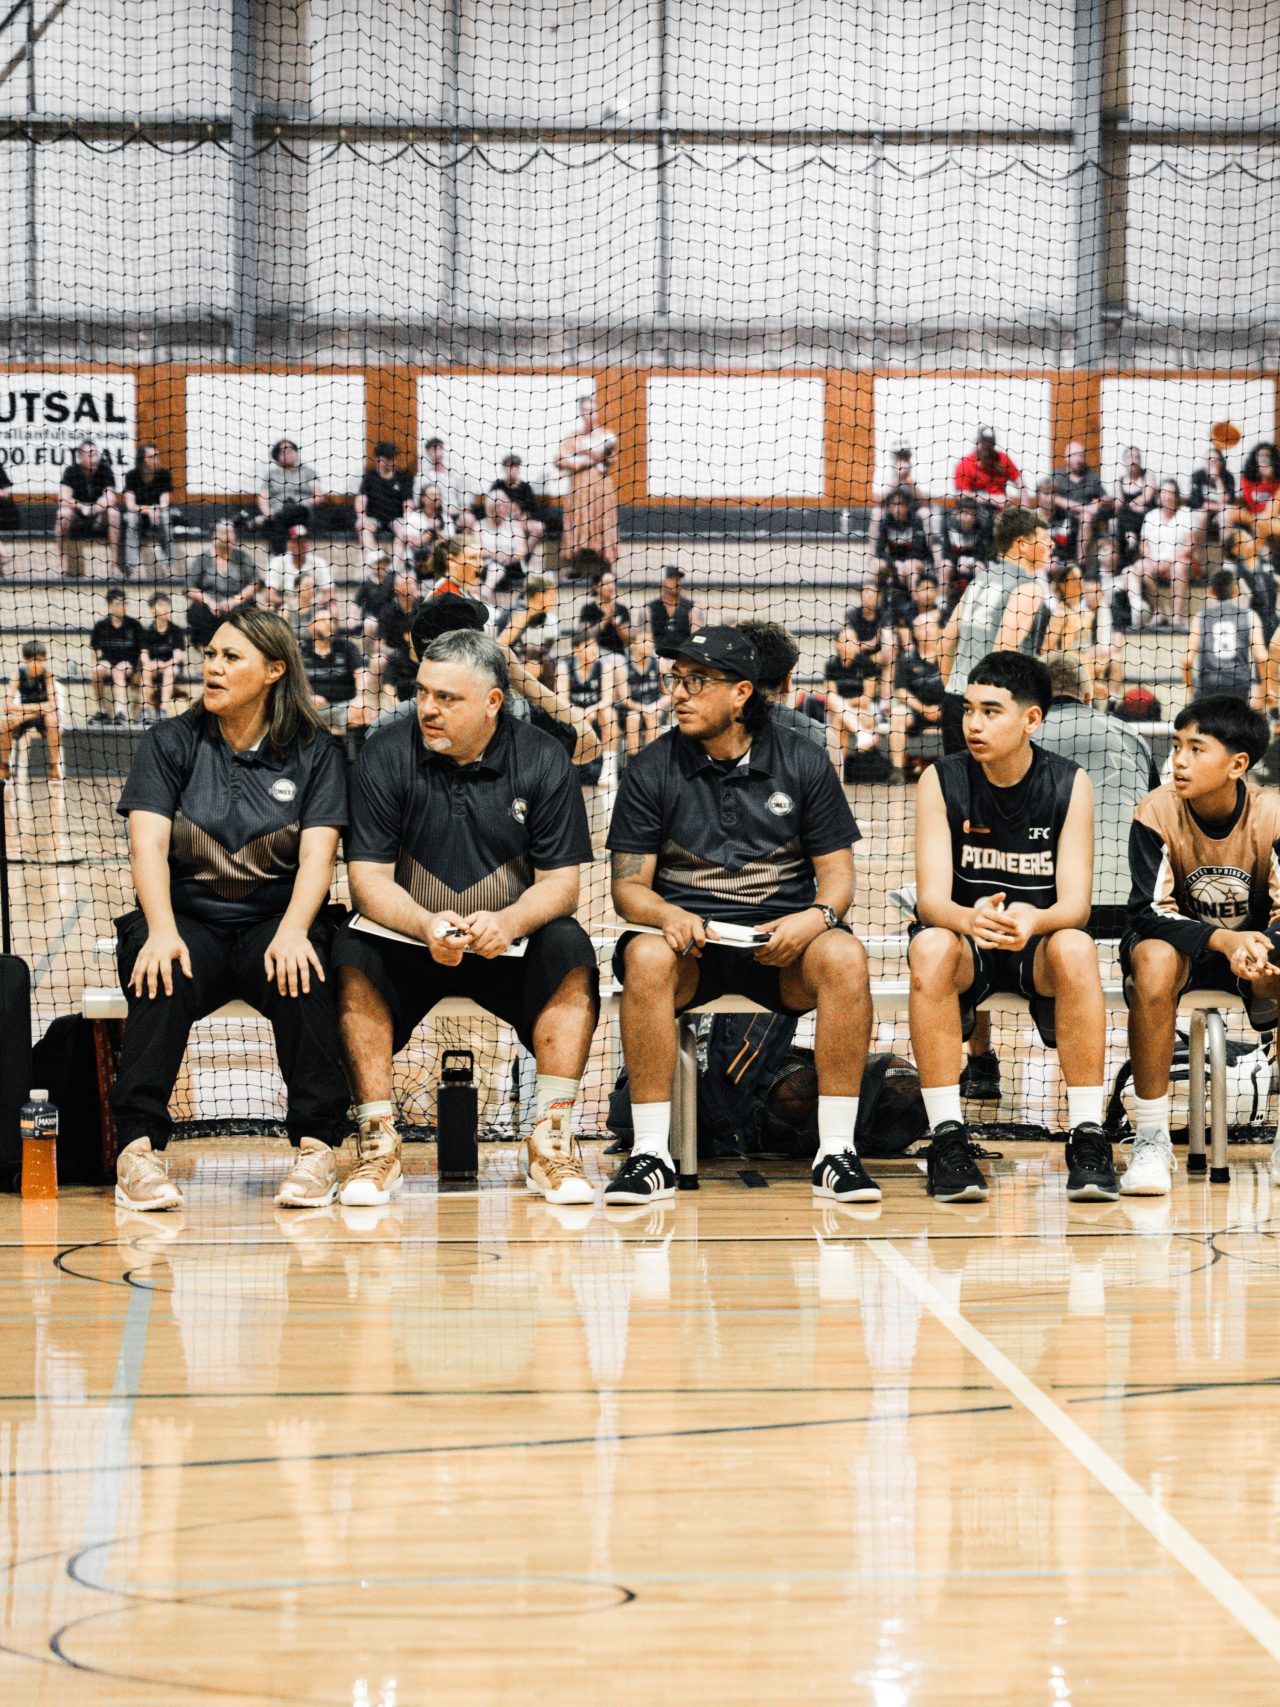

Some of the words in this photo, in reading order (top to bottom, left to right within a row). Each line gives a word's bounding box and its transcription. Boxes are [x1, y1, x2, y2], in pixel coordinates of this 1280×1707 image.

[35, 447, 128, 466] FUTAL
[961, 844, 1054, 876] PIONEERS
[1212, 867, 1251, 884] SPRINGFI
